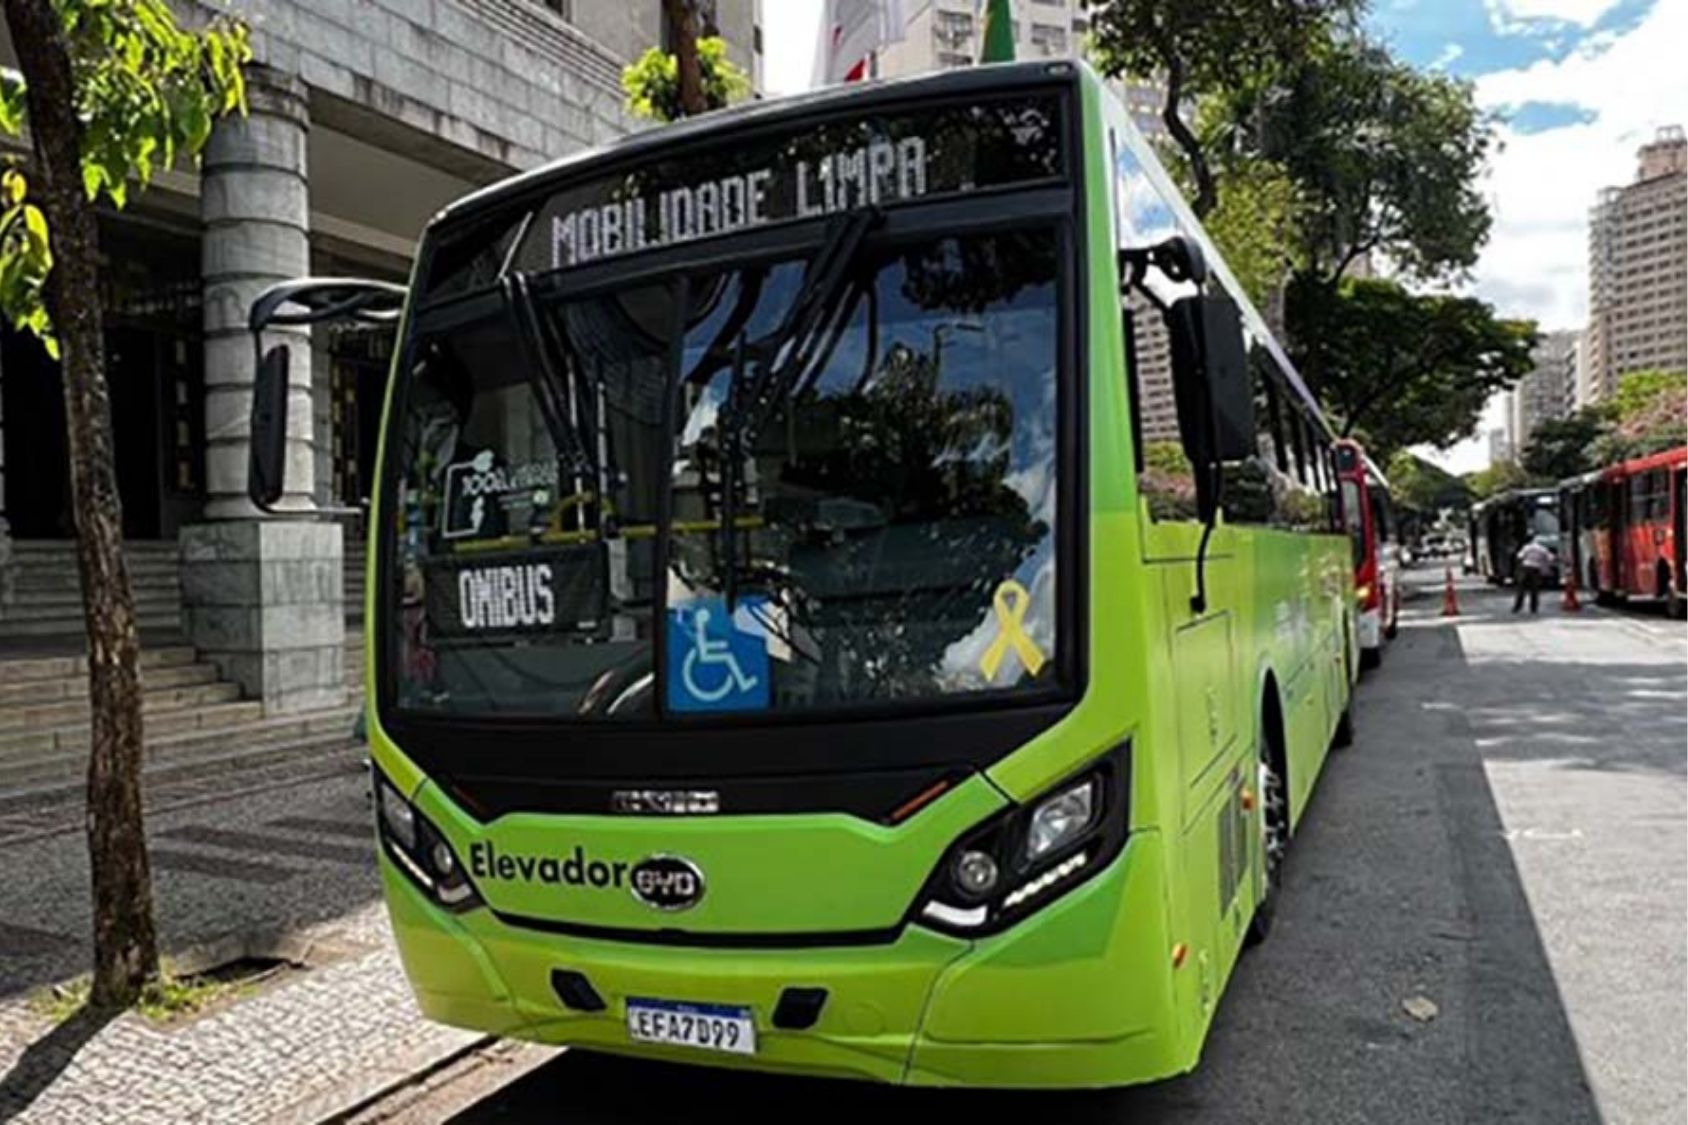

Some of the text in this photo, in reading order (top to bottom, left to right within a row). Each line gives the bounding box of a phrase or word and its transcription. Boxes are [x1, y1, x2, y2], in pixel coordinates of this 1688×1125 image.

[551, 136, 926, 269] MOBILIDADE LIMPA
[459, 564, 554, 628] ONIBUS
[470, 841, 628, 887] Elevador
[637, 1011, 740, 1047] EFA7D99
